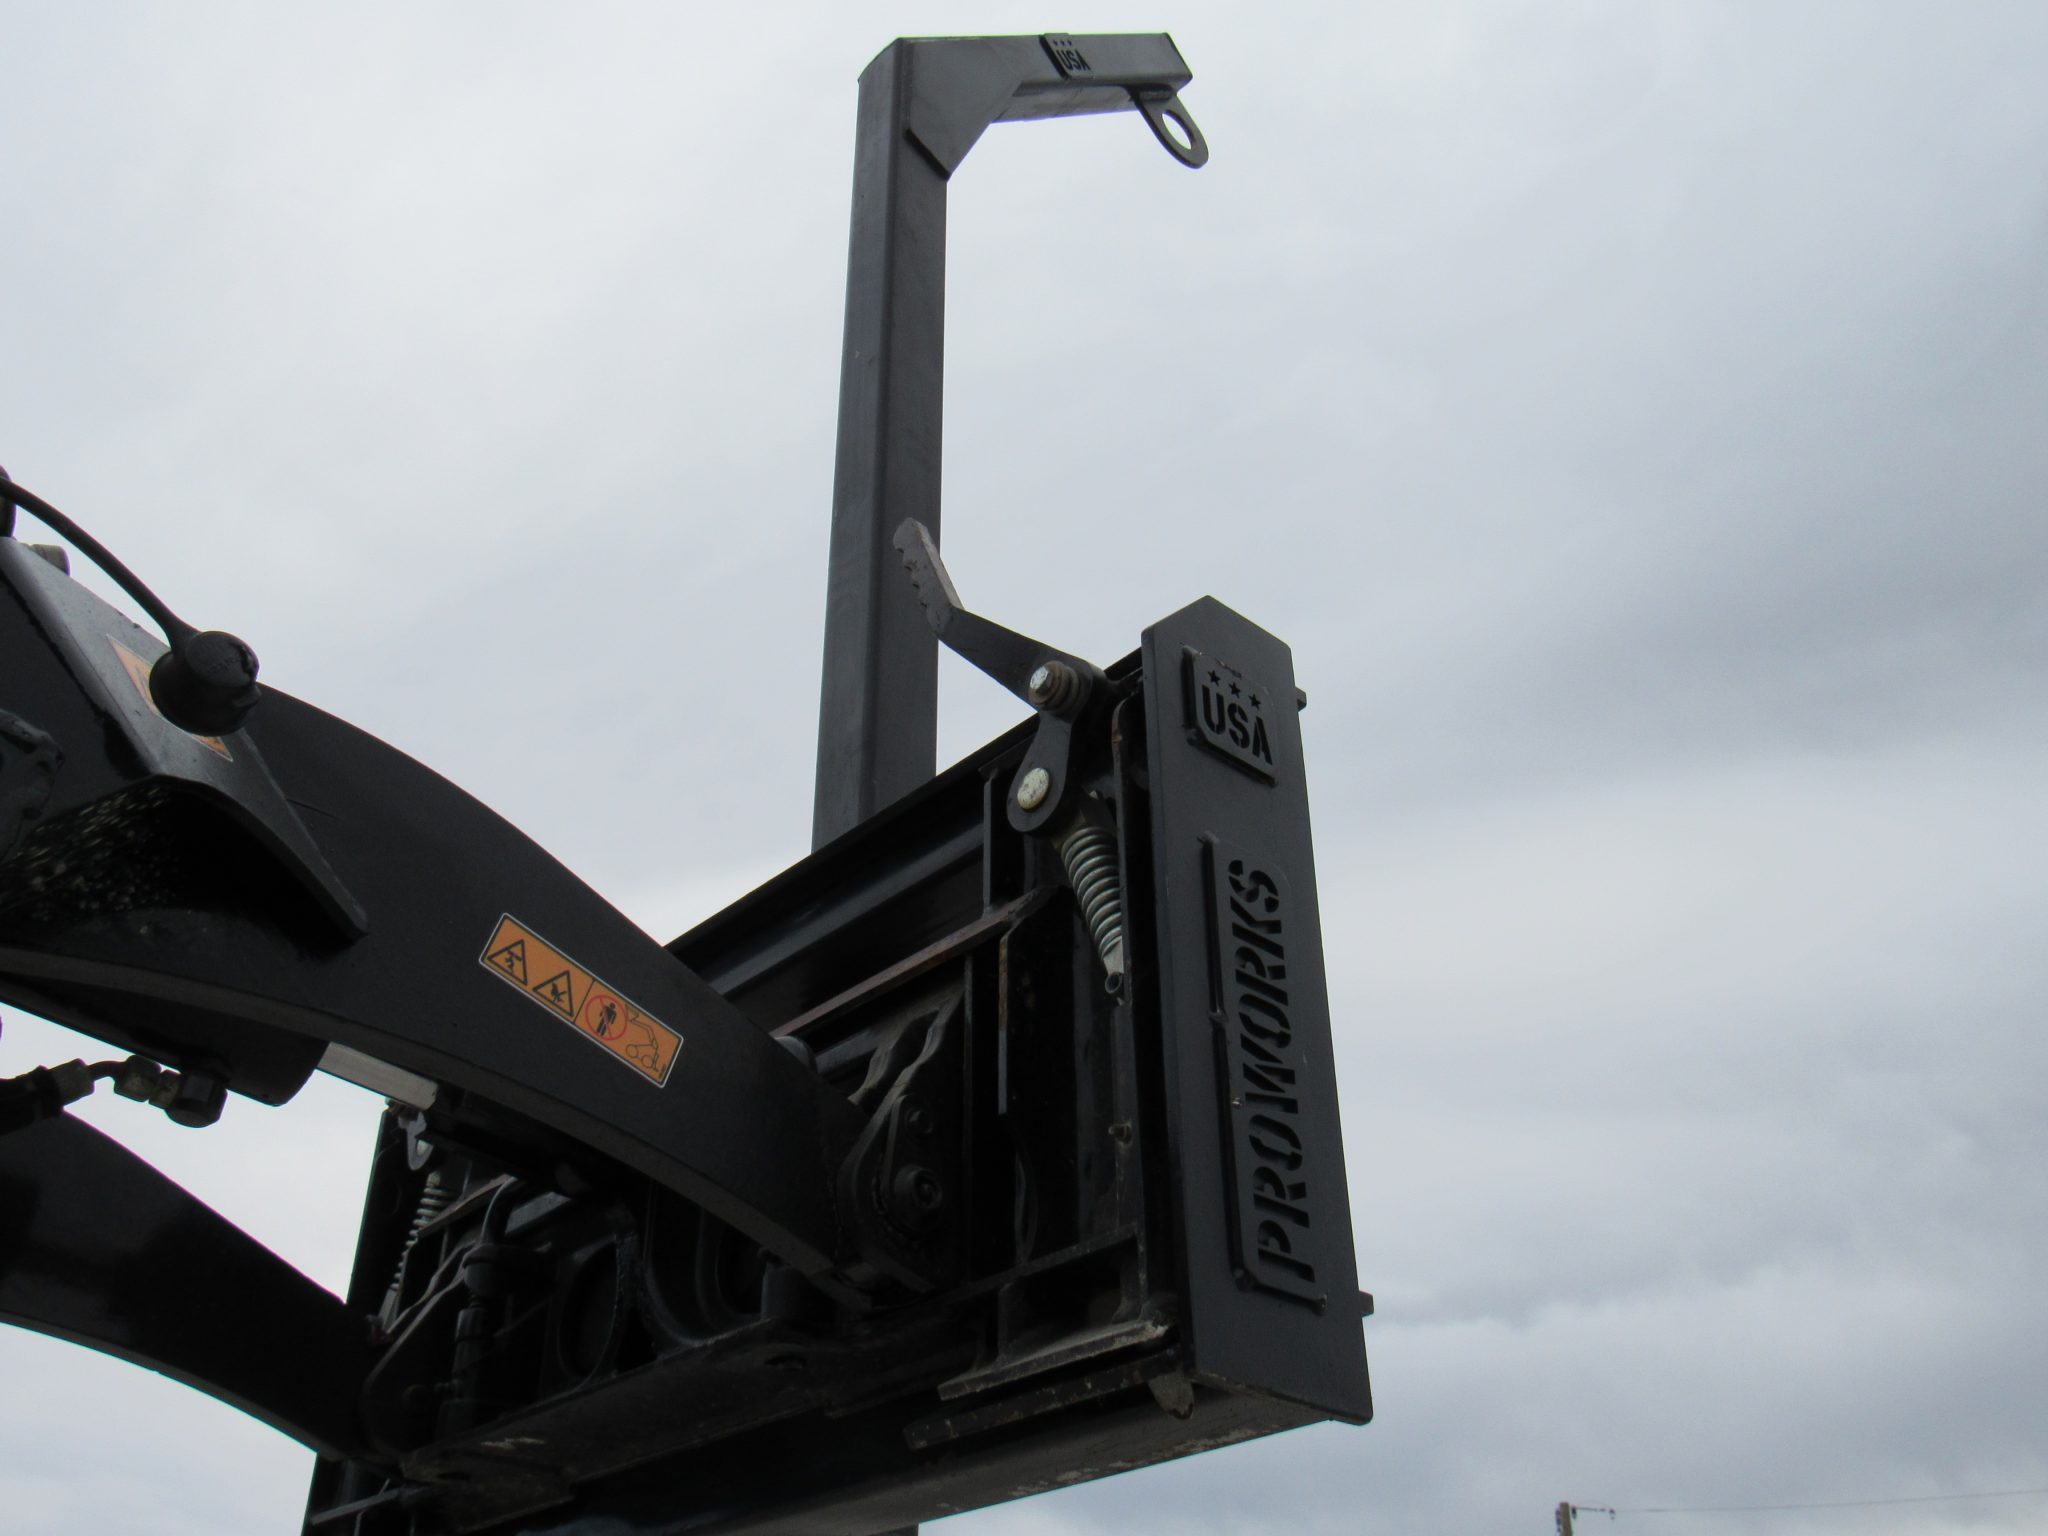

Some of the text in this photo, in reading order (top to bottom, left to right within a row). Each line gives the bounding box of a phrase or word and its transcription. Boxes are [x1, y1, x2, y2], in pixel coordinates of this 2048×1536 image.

[1056, 50, 1090, 71] USA
[1202, 684, 1273, 766] USA
[1228, 859, 1316, 1283] PROWORKS
